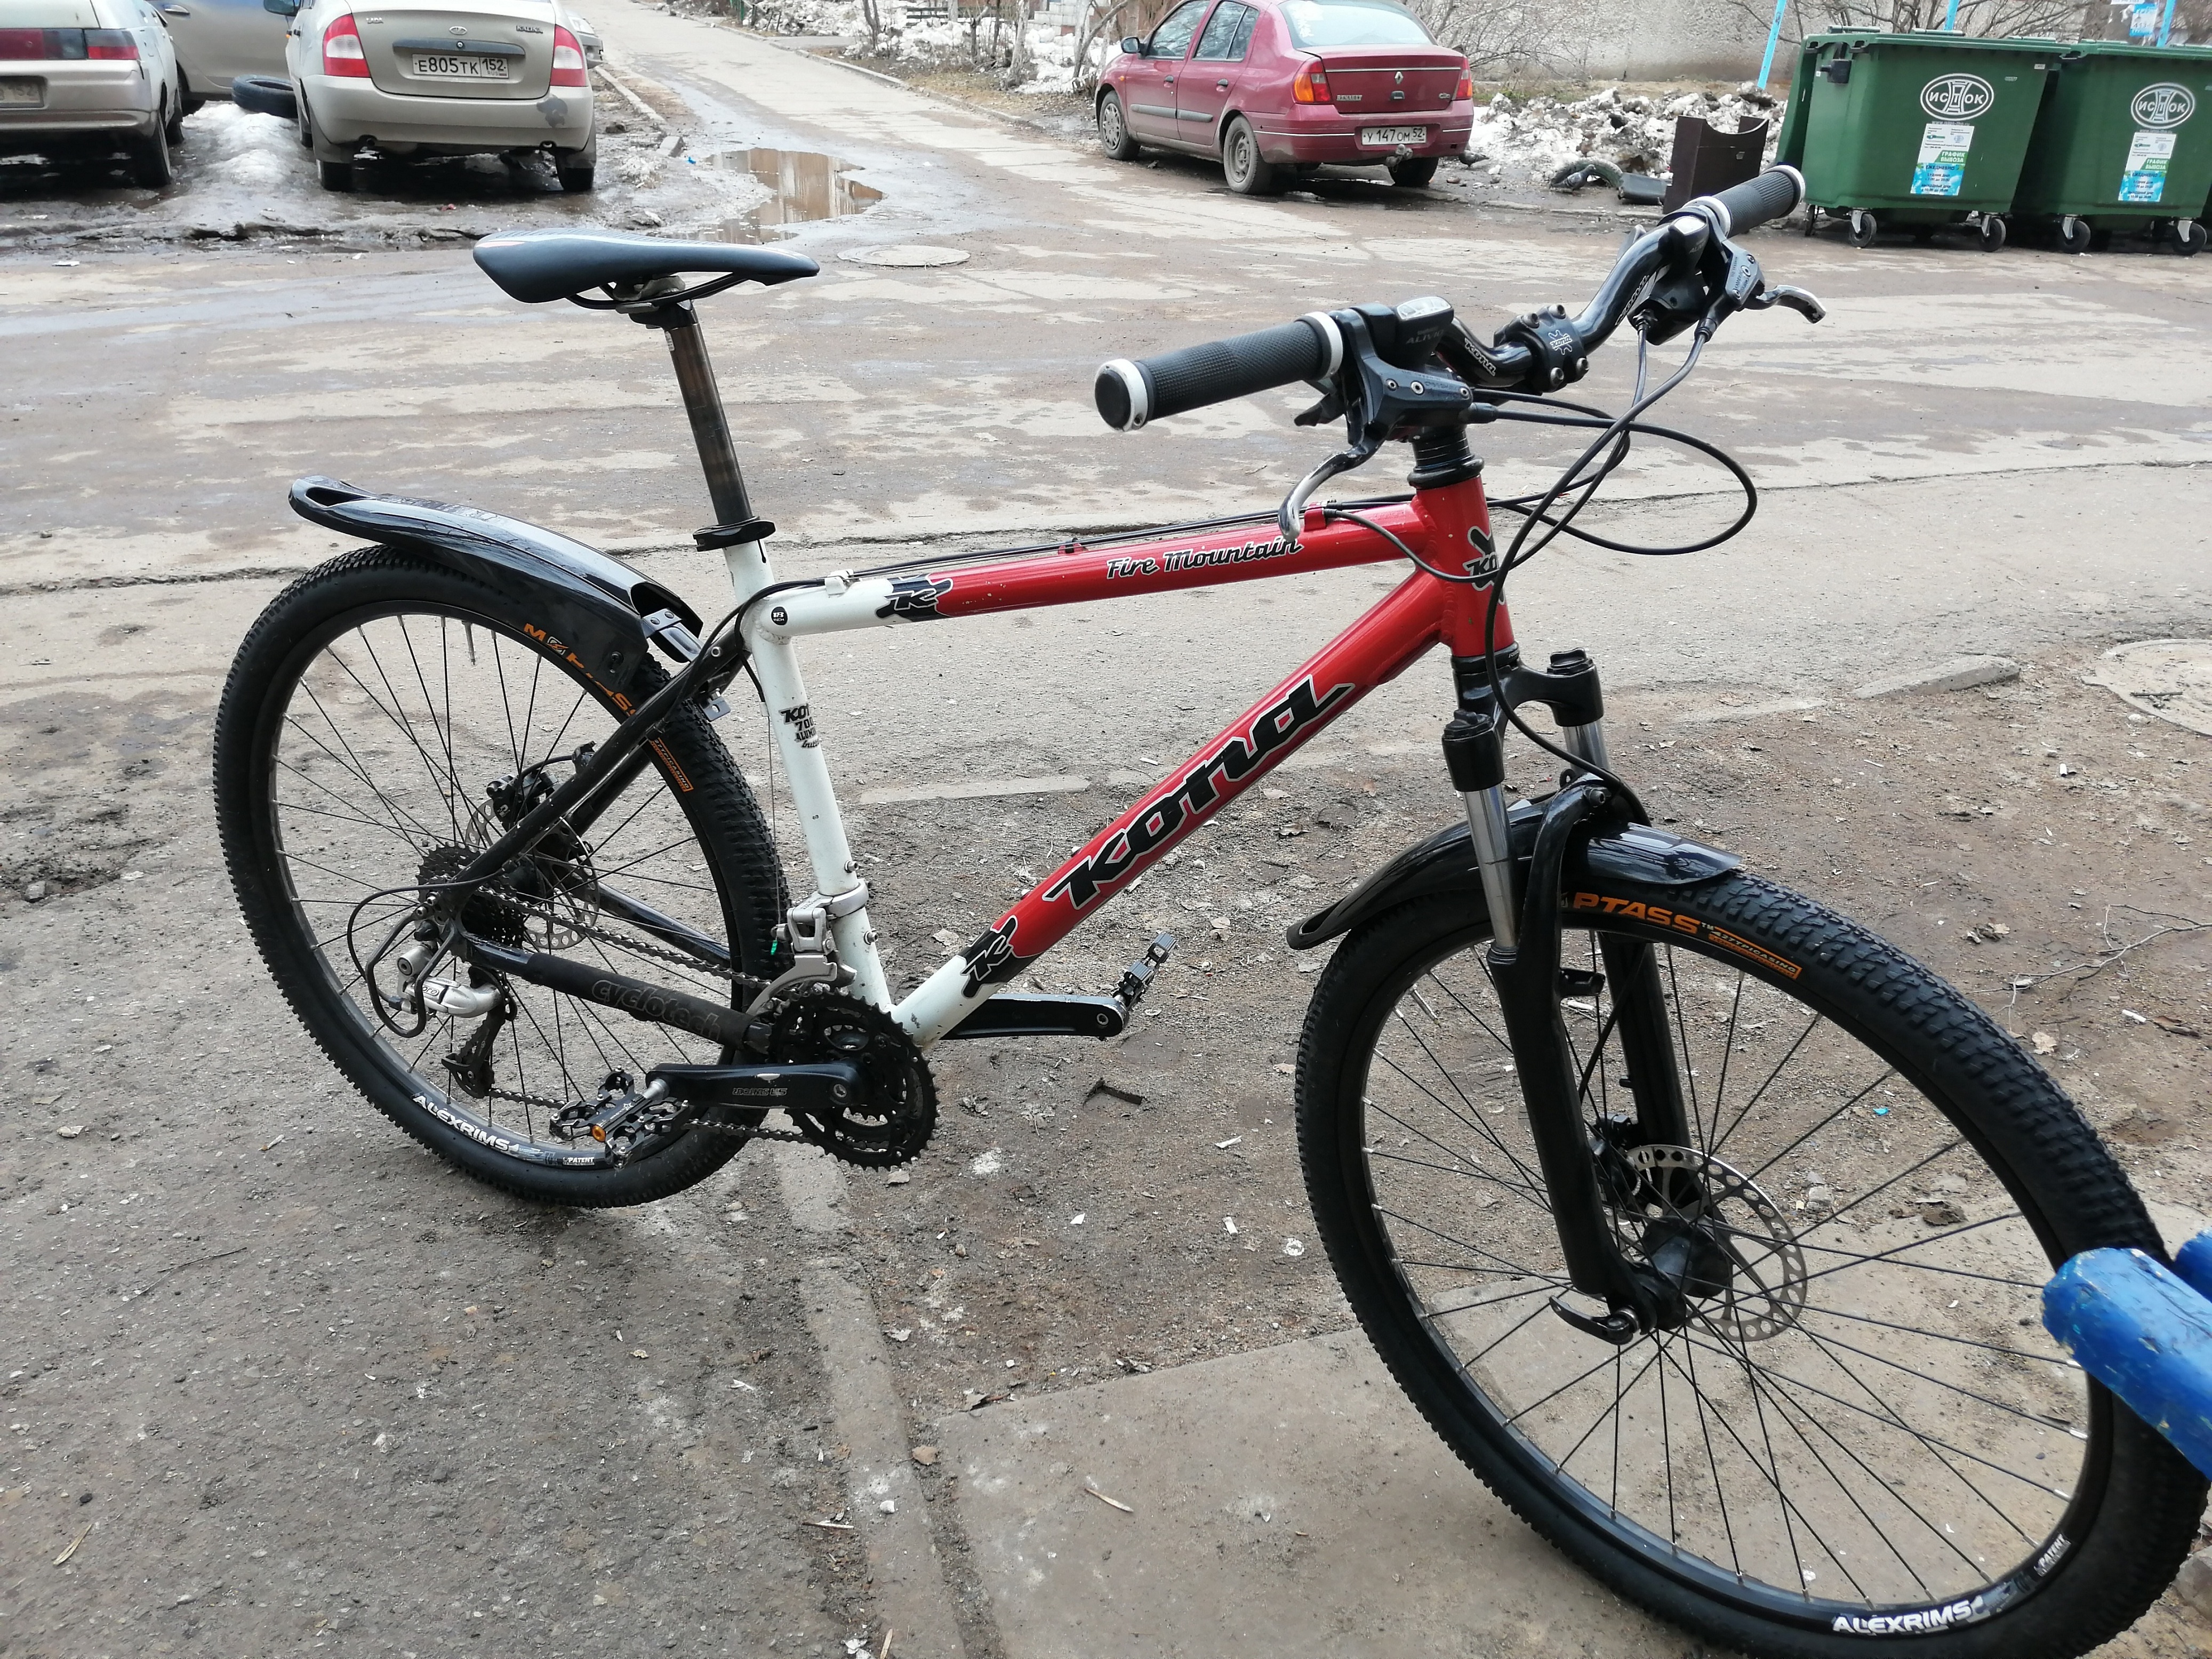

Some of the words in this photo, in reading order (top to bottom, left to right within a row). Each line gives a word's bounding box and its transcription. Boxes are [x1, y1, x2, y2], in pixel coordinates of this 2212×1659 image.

[482, 58, 504, 71] 152
[1413, 128, 1423, 138] 52
[1107, 557, 1159, 580] Fire
[1163, 535, 1304, 573] Mountain
[1043, 674, 1356, 910] Kona
[591, 979, 720, 1041] cyclotech
[413, 1095, 510, 1152] ALEXRIMS
[1833, 1599, 1973, 1634] ALEXRIMS
